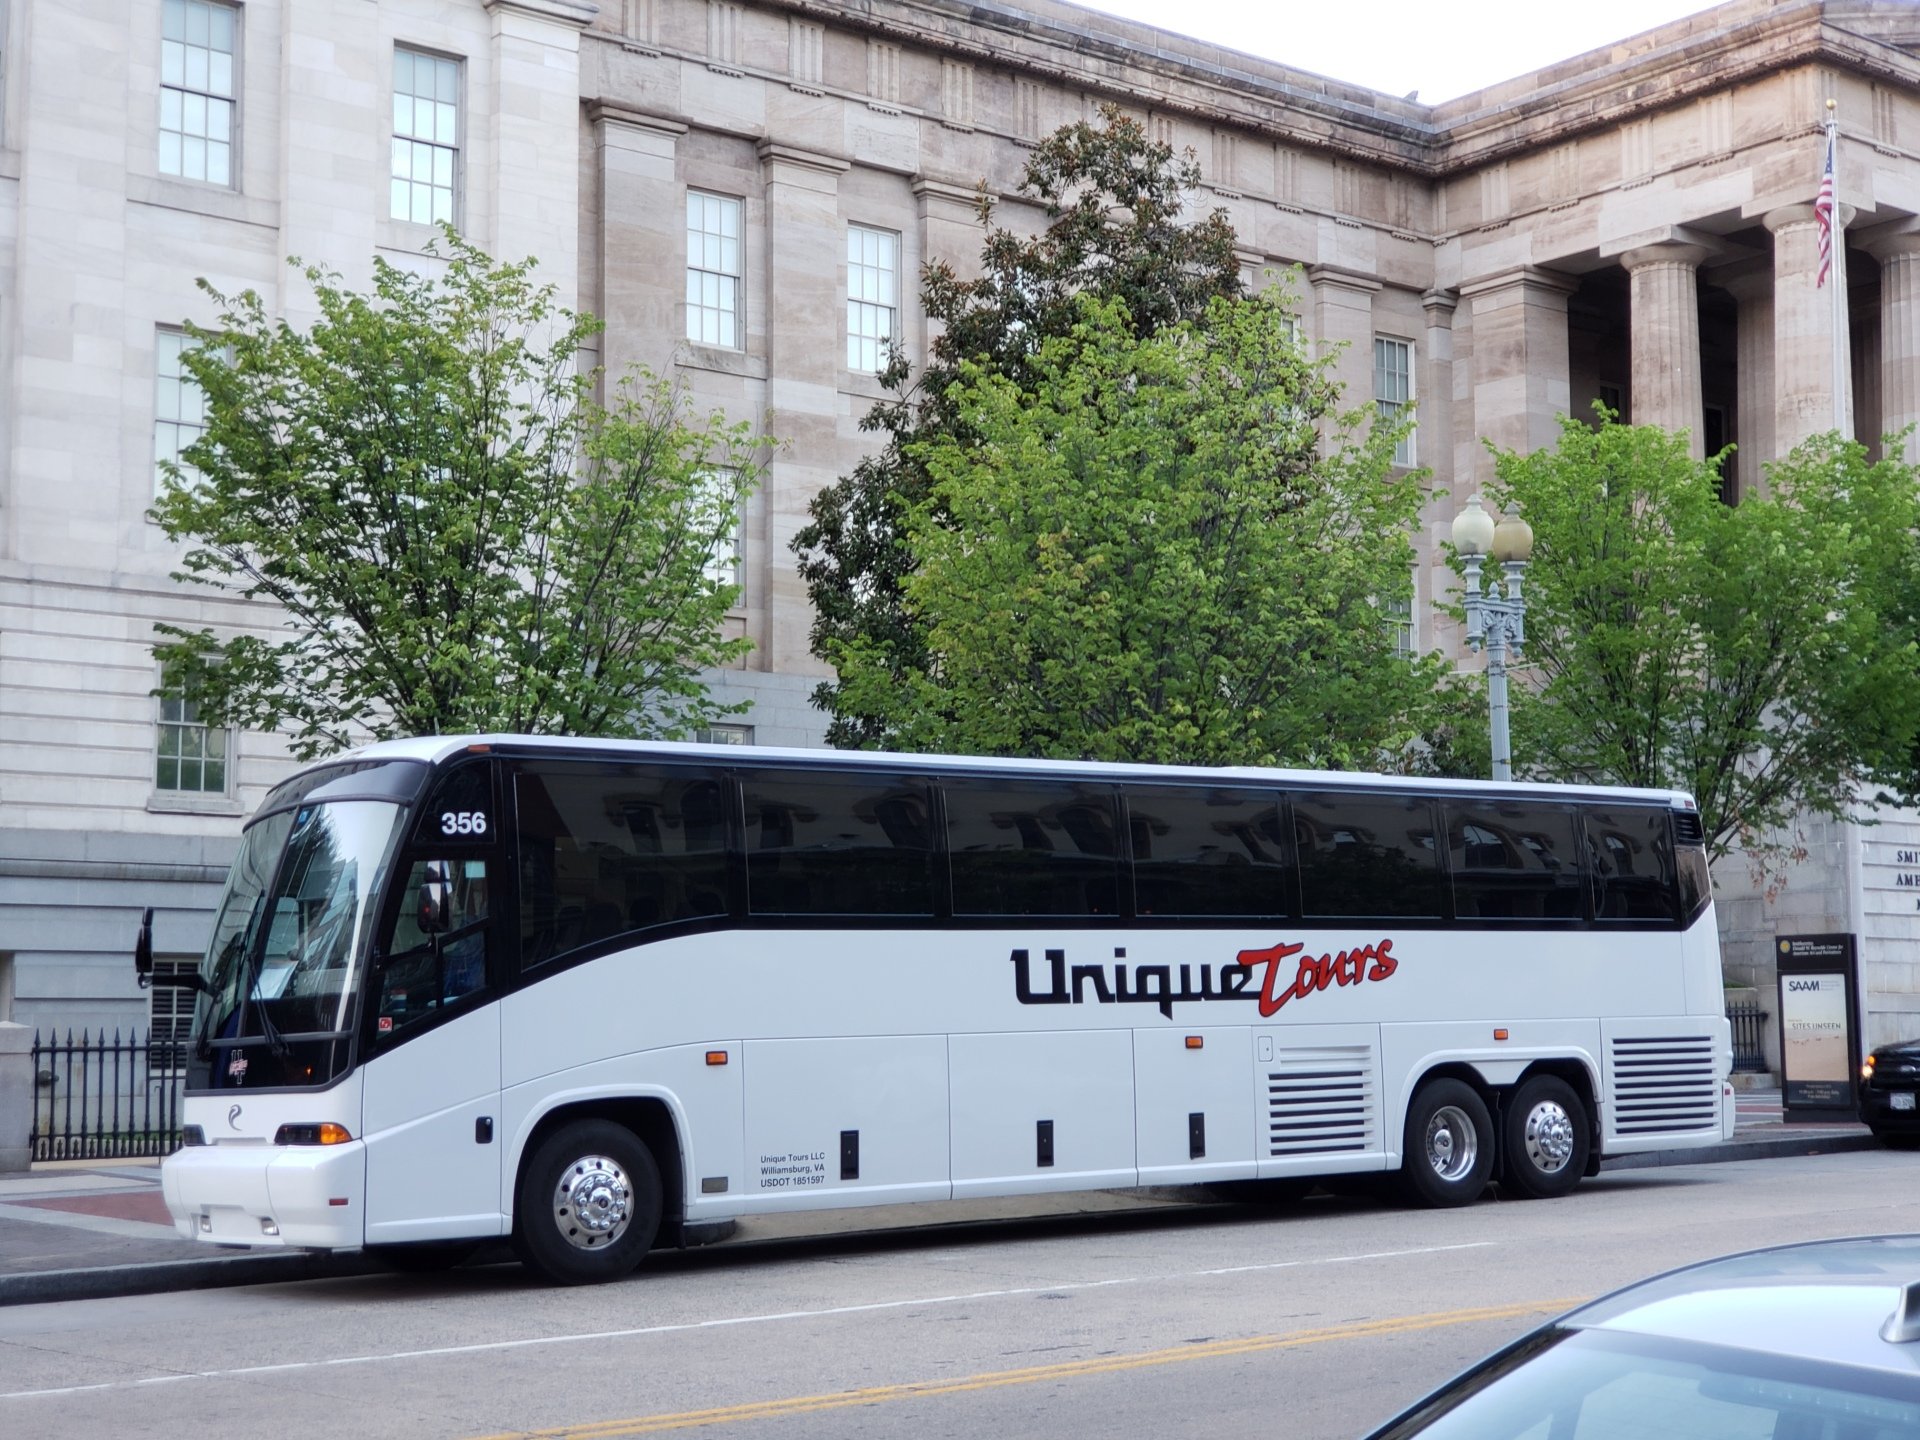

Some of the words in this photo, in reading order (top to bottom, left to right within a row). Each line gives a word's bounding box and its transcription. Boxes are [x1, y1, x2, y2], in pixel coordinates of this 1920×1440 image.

[442, 812, 486, 834] 356
[1897, 850, 1920, 863] SMI
[1010, 947, 1262, 1020] Unique
[1237, 939, 1398, 1018] Tours
[1789, 980, 1820, 992] SAAM
[1792, 1022, 1811, 1030] SITES
[1813, 1022, 1841, 1030] UNSEEN
[761, 1155, 786, 1164] Unique
[788, 1154, 808, 1162] Tours
[810, 1152, 825, 1160] LLC
[761, 1165, 812, 1174] Williamsburg,
[814, 1163, 825, 1172] VA
[761, 1177, 790, 1188] USDOT
[793, 1175, 825, 1185] 1851597
